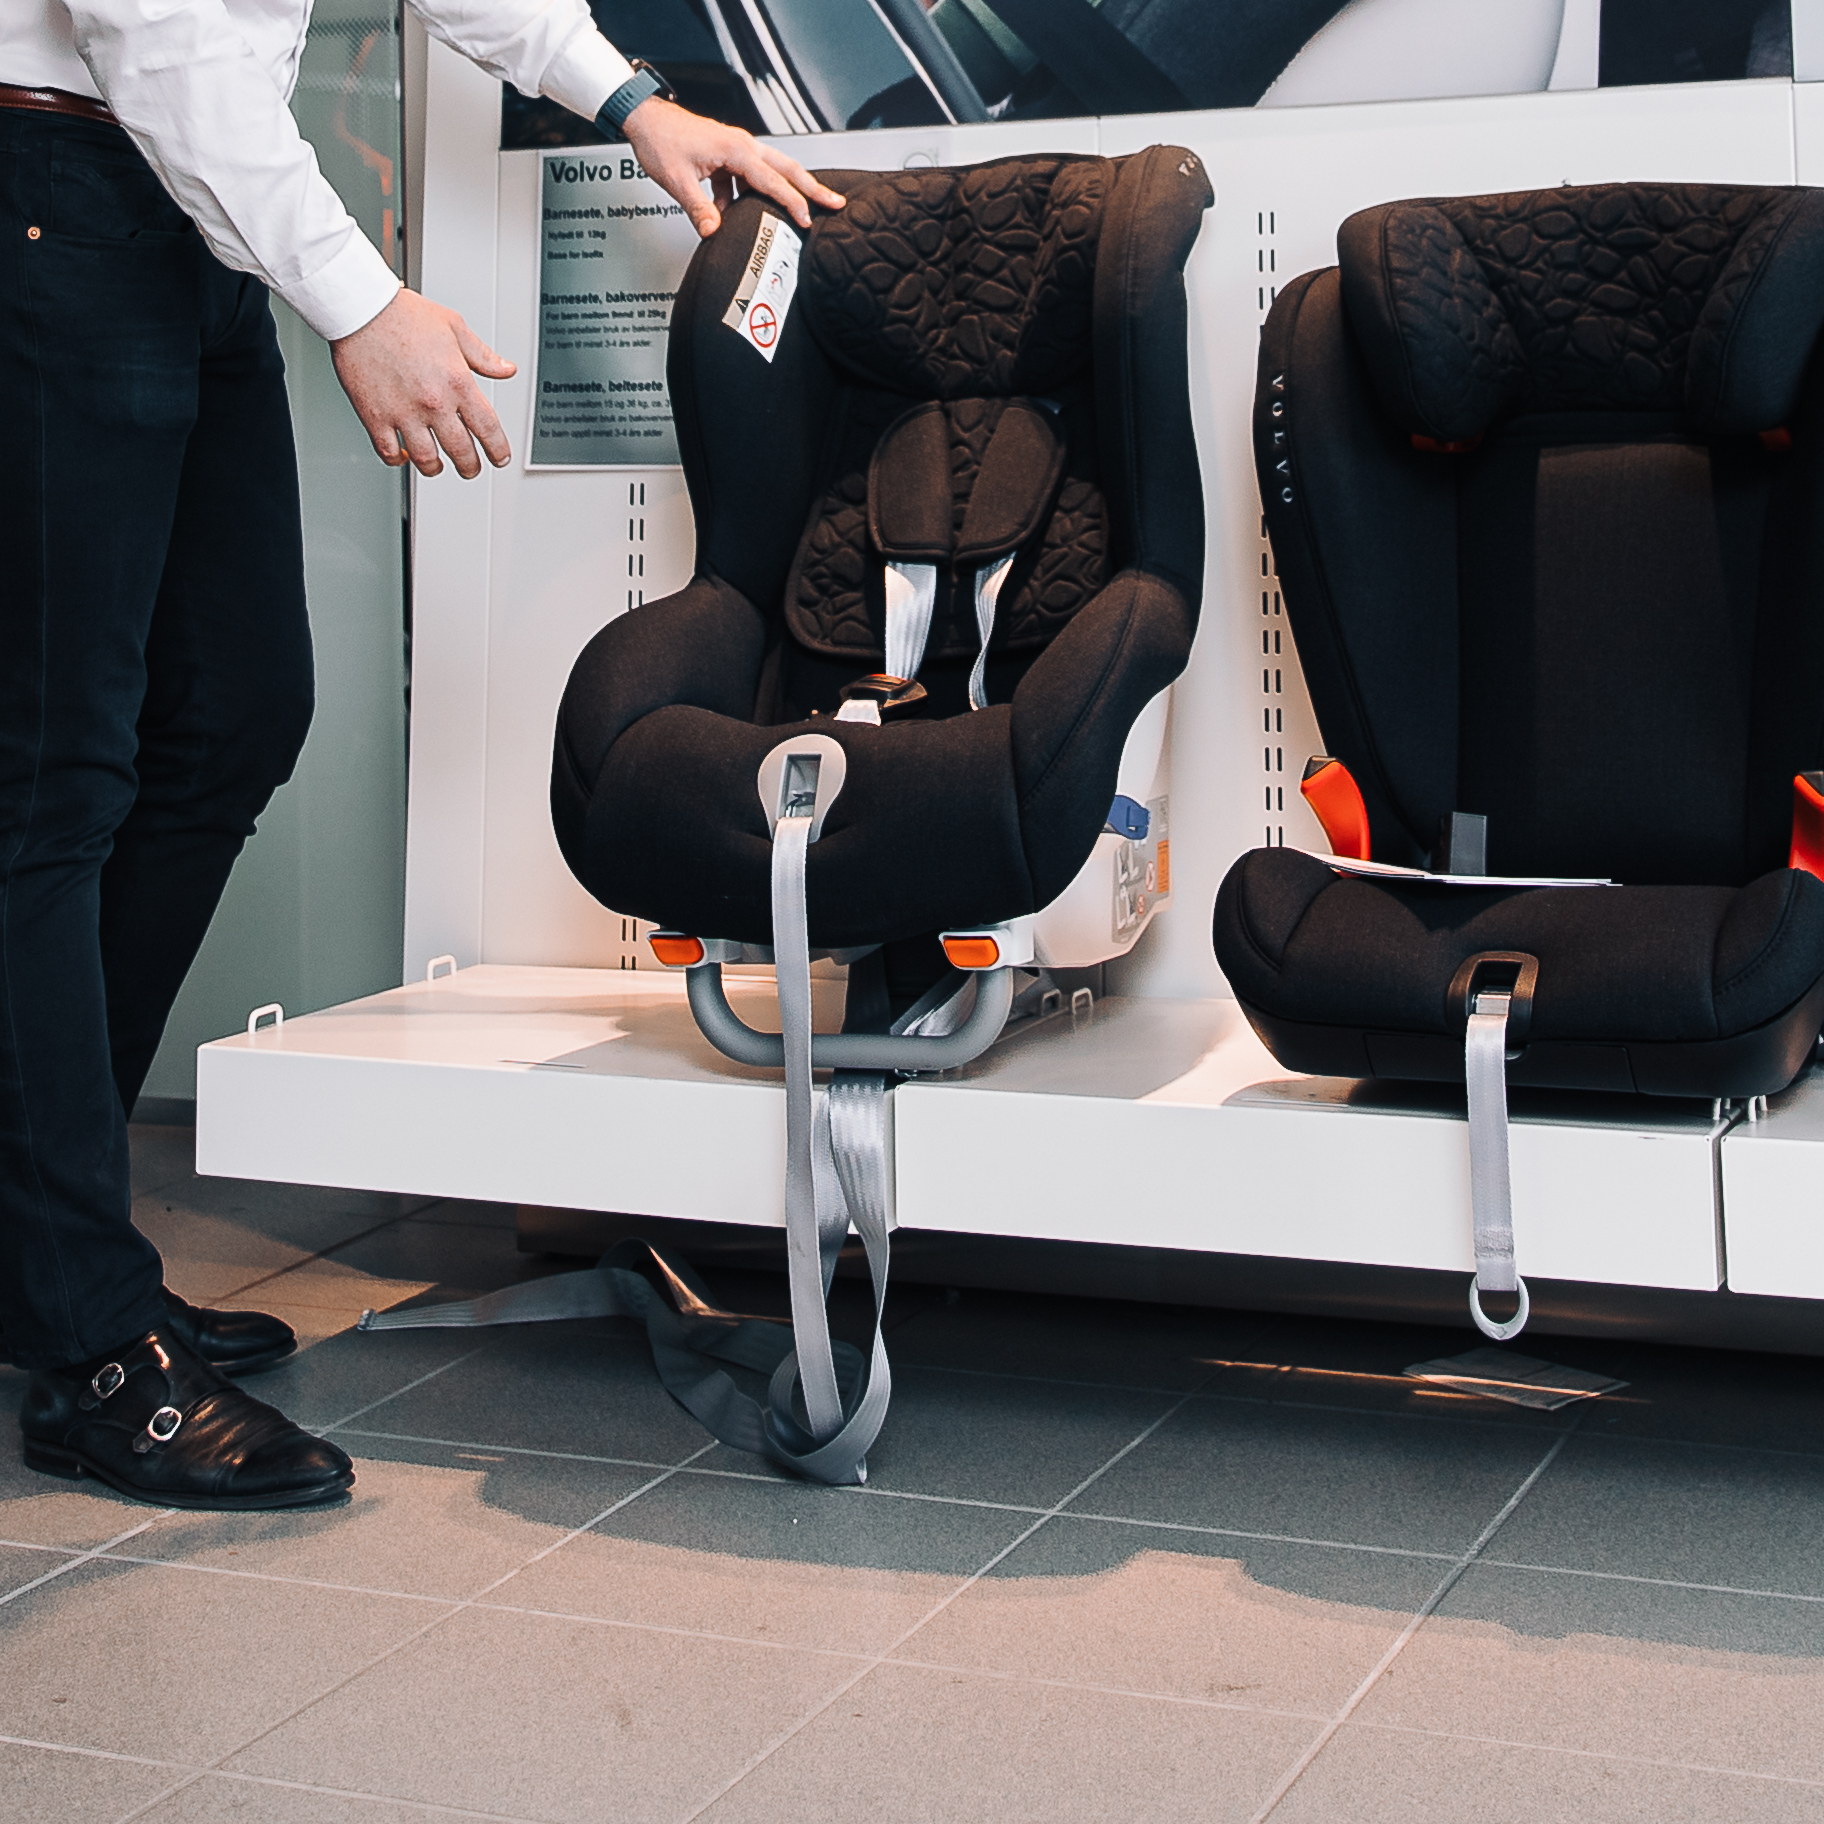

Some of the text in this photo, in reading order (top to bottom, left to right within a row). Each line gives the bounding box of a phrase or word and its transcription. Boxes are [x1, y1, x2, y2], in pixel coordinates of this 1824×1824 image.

[549, 160, 612, 183] Volvo
[607, 204, 684, 220] babybeskytte
[749, 227, 773, 278] AIRBAG
[605, 291, 676, 304] bakoverven
[1272, 374, 1294, 503] VOLVO
